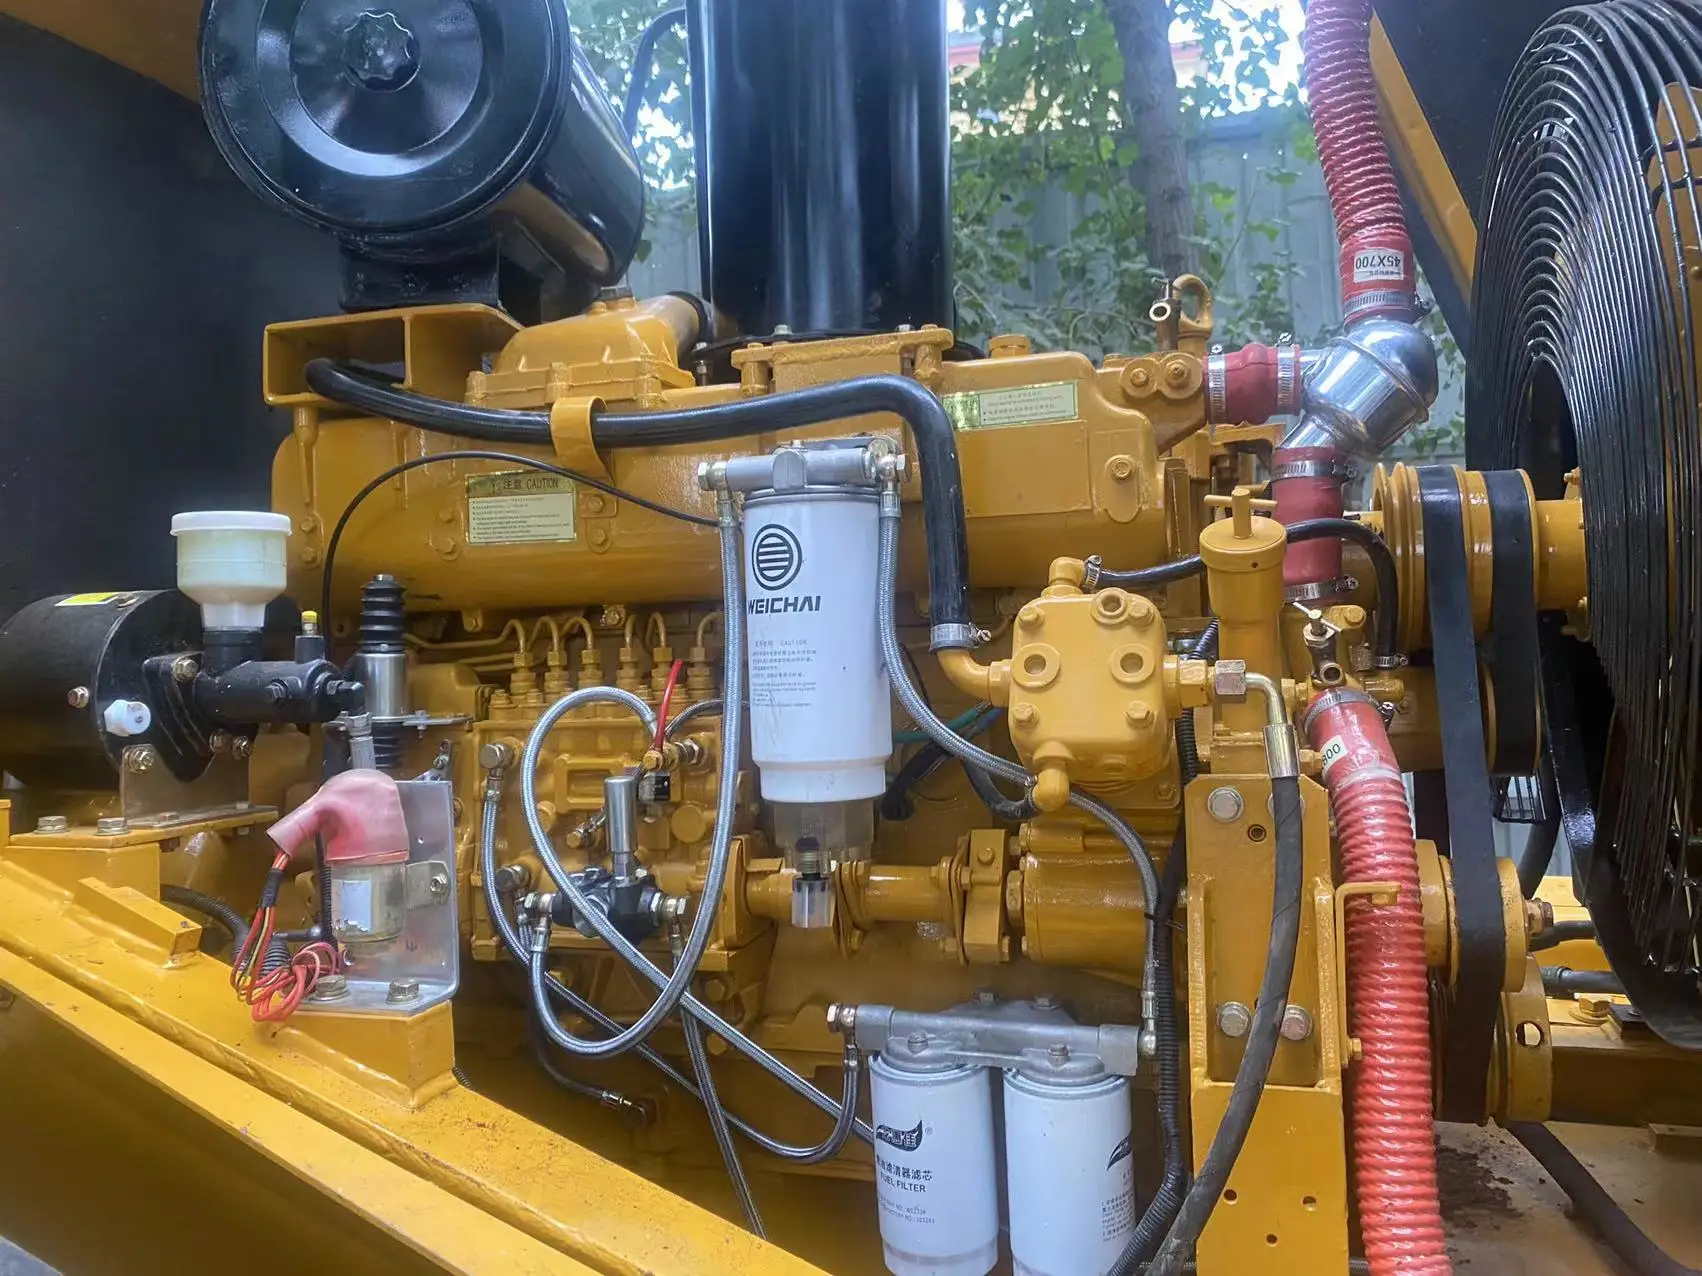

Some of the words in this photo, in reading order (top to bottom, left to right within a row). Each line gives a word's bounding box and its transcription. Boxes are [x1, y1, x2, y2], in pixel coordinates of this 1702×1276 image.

[1355, 256, 1400, 269] 45X700
[526, 477, 559, 489] CAUTION
[747, 595, 821, 614] WEICHAI
[896, 1179, 926, 1192] FILTER
